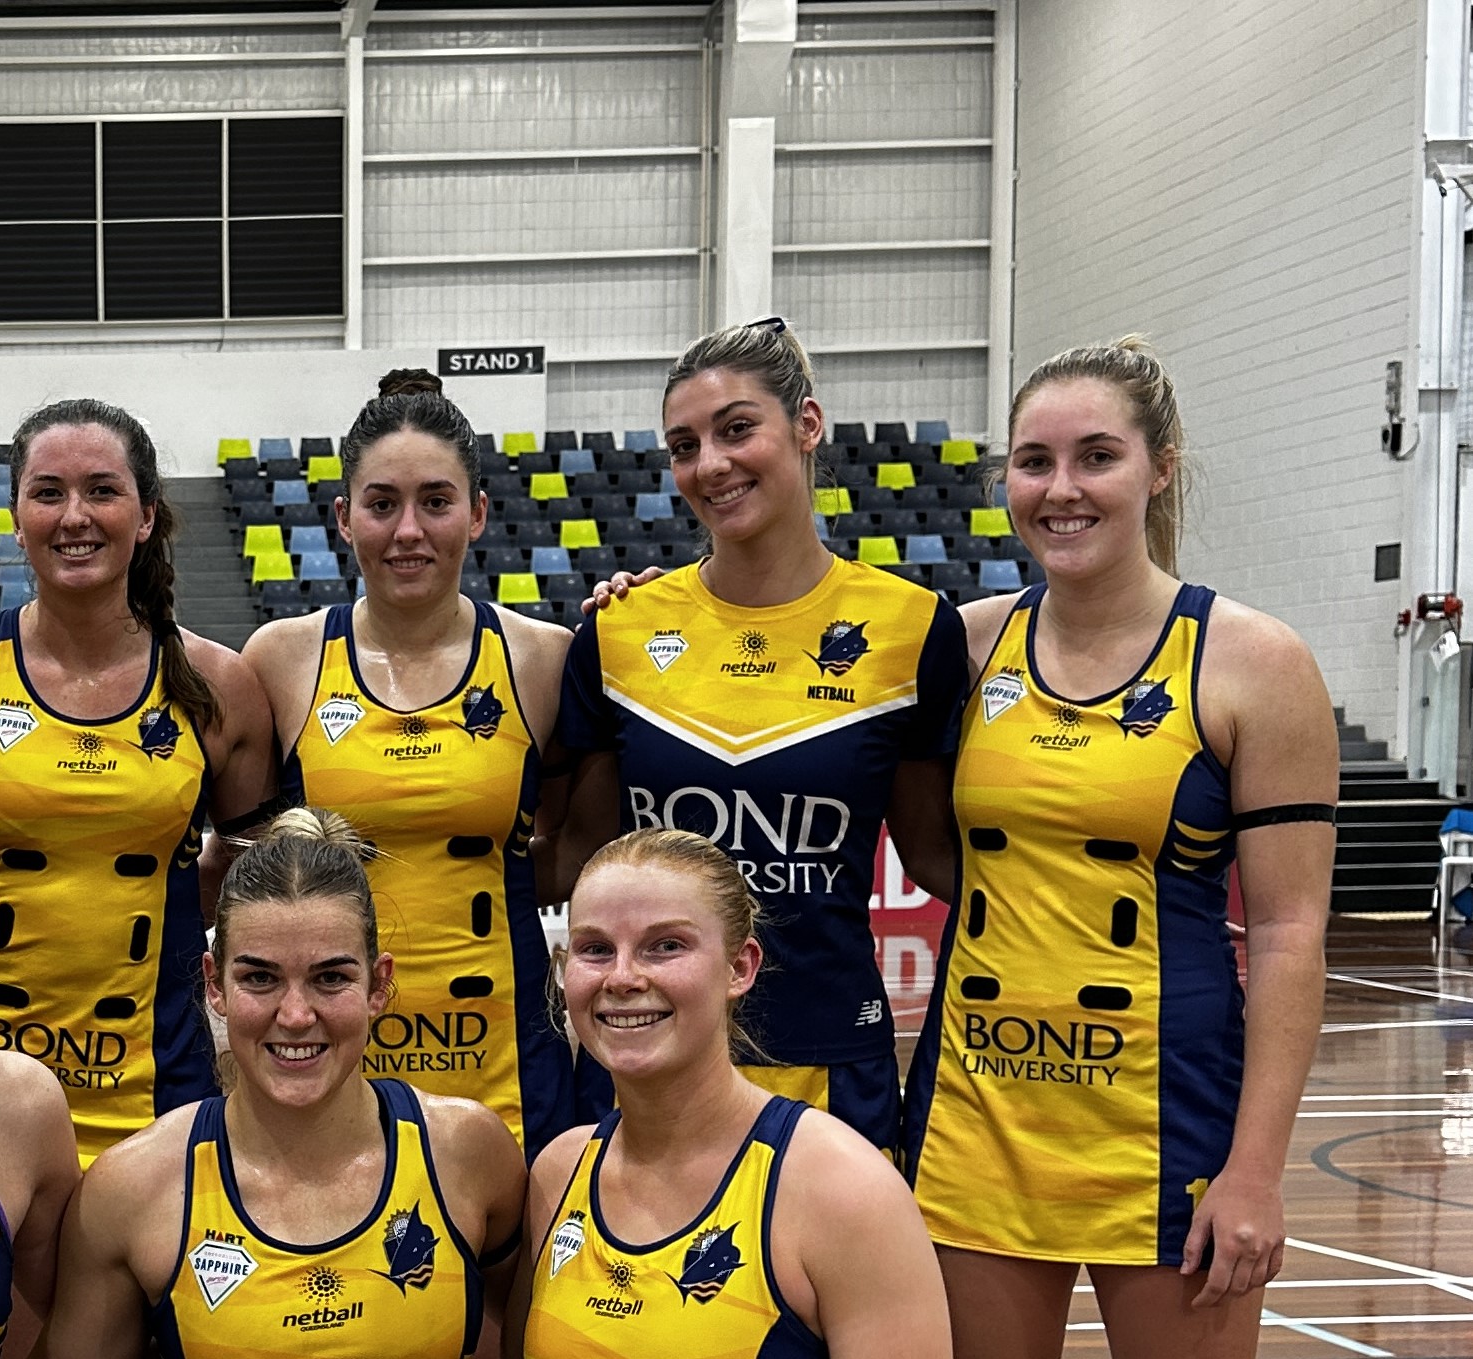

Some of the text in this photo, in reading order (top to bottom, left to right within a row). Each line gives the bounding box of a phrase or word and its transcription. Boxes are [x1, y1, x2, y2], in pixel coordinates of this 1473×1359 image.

[449, 352, 534, 371] STAND 1
[720, 661, 777, 675] netball
[807, 685, 857, 703] NETBALL
[0, 698, 32, 710] HART
[320, 710, 361, 722] SAPPHIRE
[383, 742, 442, 757] netball
[1030, 733, 1091, 748] netball
[56, 759, 117, 771] netball
[628, 786, 851, 857] BOND
[366, 1012, 488, 1051] OND
[964, 1012, 1125, 1061] BOND
[362, 1050, 488, 1074] NIVERSITY
[961, 1053, 1122, 1086] UNIVERSITY
[205, 1228, 247, 1246] HART
[194, 1257, 250, 1276] SAPPHIRE
[282, 1301, 364, 1328] netball
[585, 1296, 644, 1316] netball
